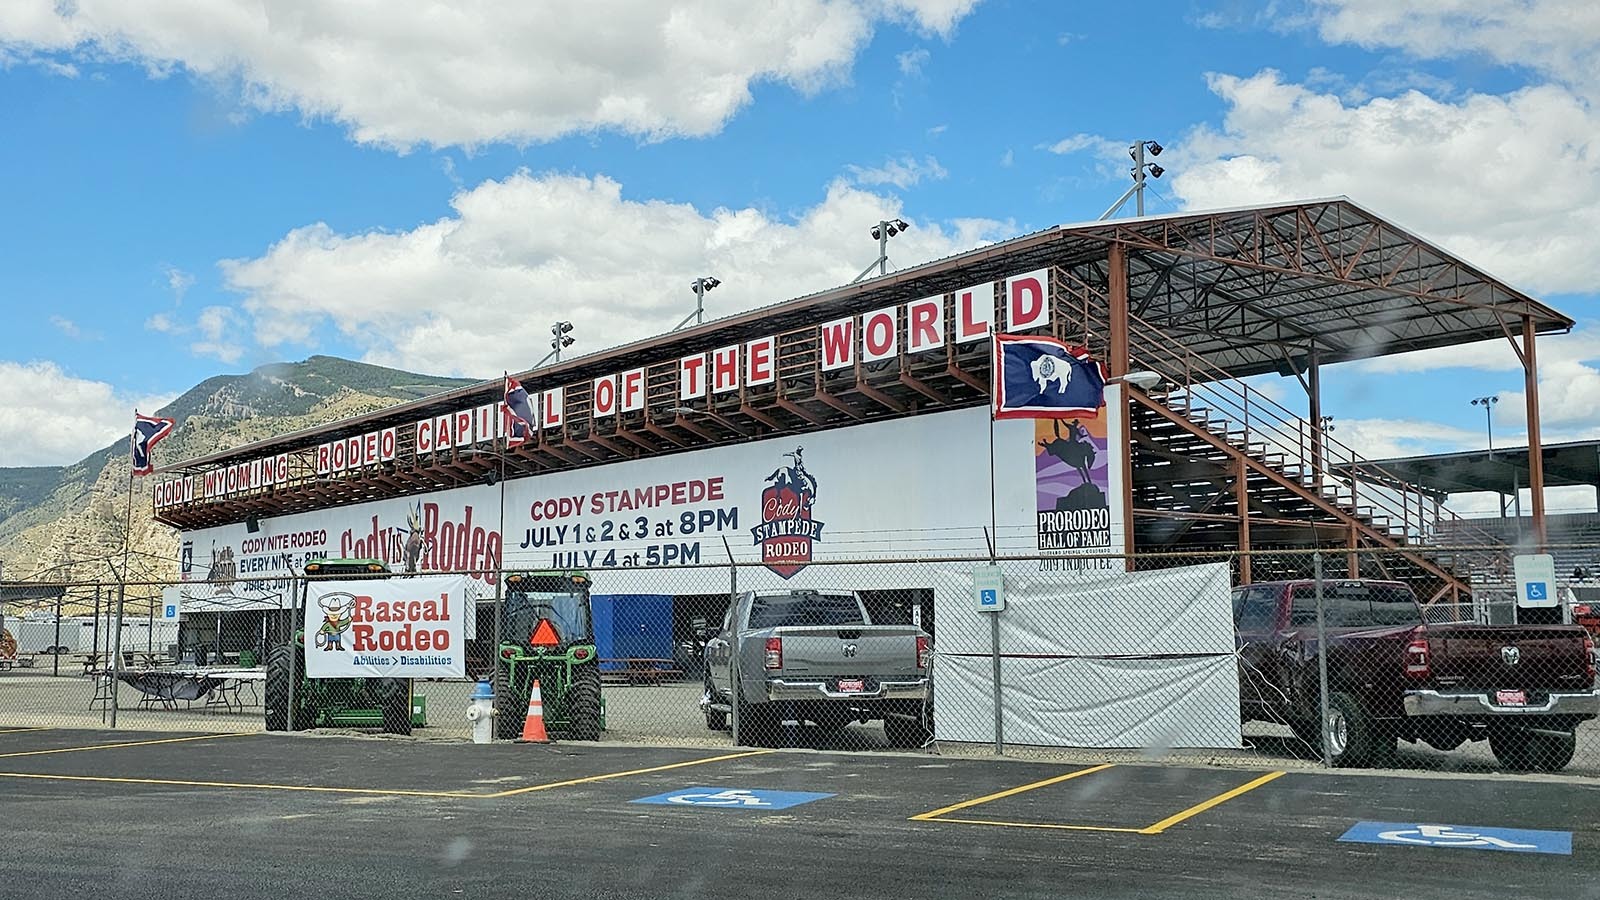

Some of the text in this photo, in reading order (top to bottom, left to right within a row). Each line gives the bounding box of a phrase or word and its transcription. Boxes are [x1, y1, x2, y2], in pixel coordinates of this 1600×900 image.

[156, 277, 1043, 507] CODY WYOMING RODEO CAPIL OF THE WORLD
[530, 477, 724, 521] CODY STAMPEDE
[763, 497, 800, 522] Cody
[520, 507, 738, 549] JULY 1 & 2 & 3 at 8PM
[756, 519, 818, 541] STAMPEDE
[1039, 508, 1109, 533] PRORODEO
[242, 538, 267, 554] CODY
[268, 534, 289, 551] NITE
[291, 529, 327, 548] RODEO
[341, 515, 392, 564] Cody
[421, 503, 502, 585] Rodeo
[766, 541, 808, 558] RODEO
[1039, 530, 1110, 549] HALL OF FAME
[240, 556, 271, 573] EVERY
[272, 553, 293, 571] NITE
[295, 558, 302, 568] at
[552, 542, 700, 569] JULY 4 at 5PM
[352, 593, 450, 622] Rascal
[352, 624, 450, 651] Rodeo
[353, 655, 390, 666] Abilities
[401, 655, 451, 666] Disabilities
